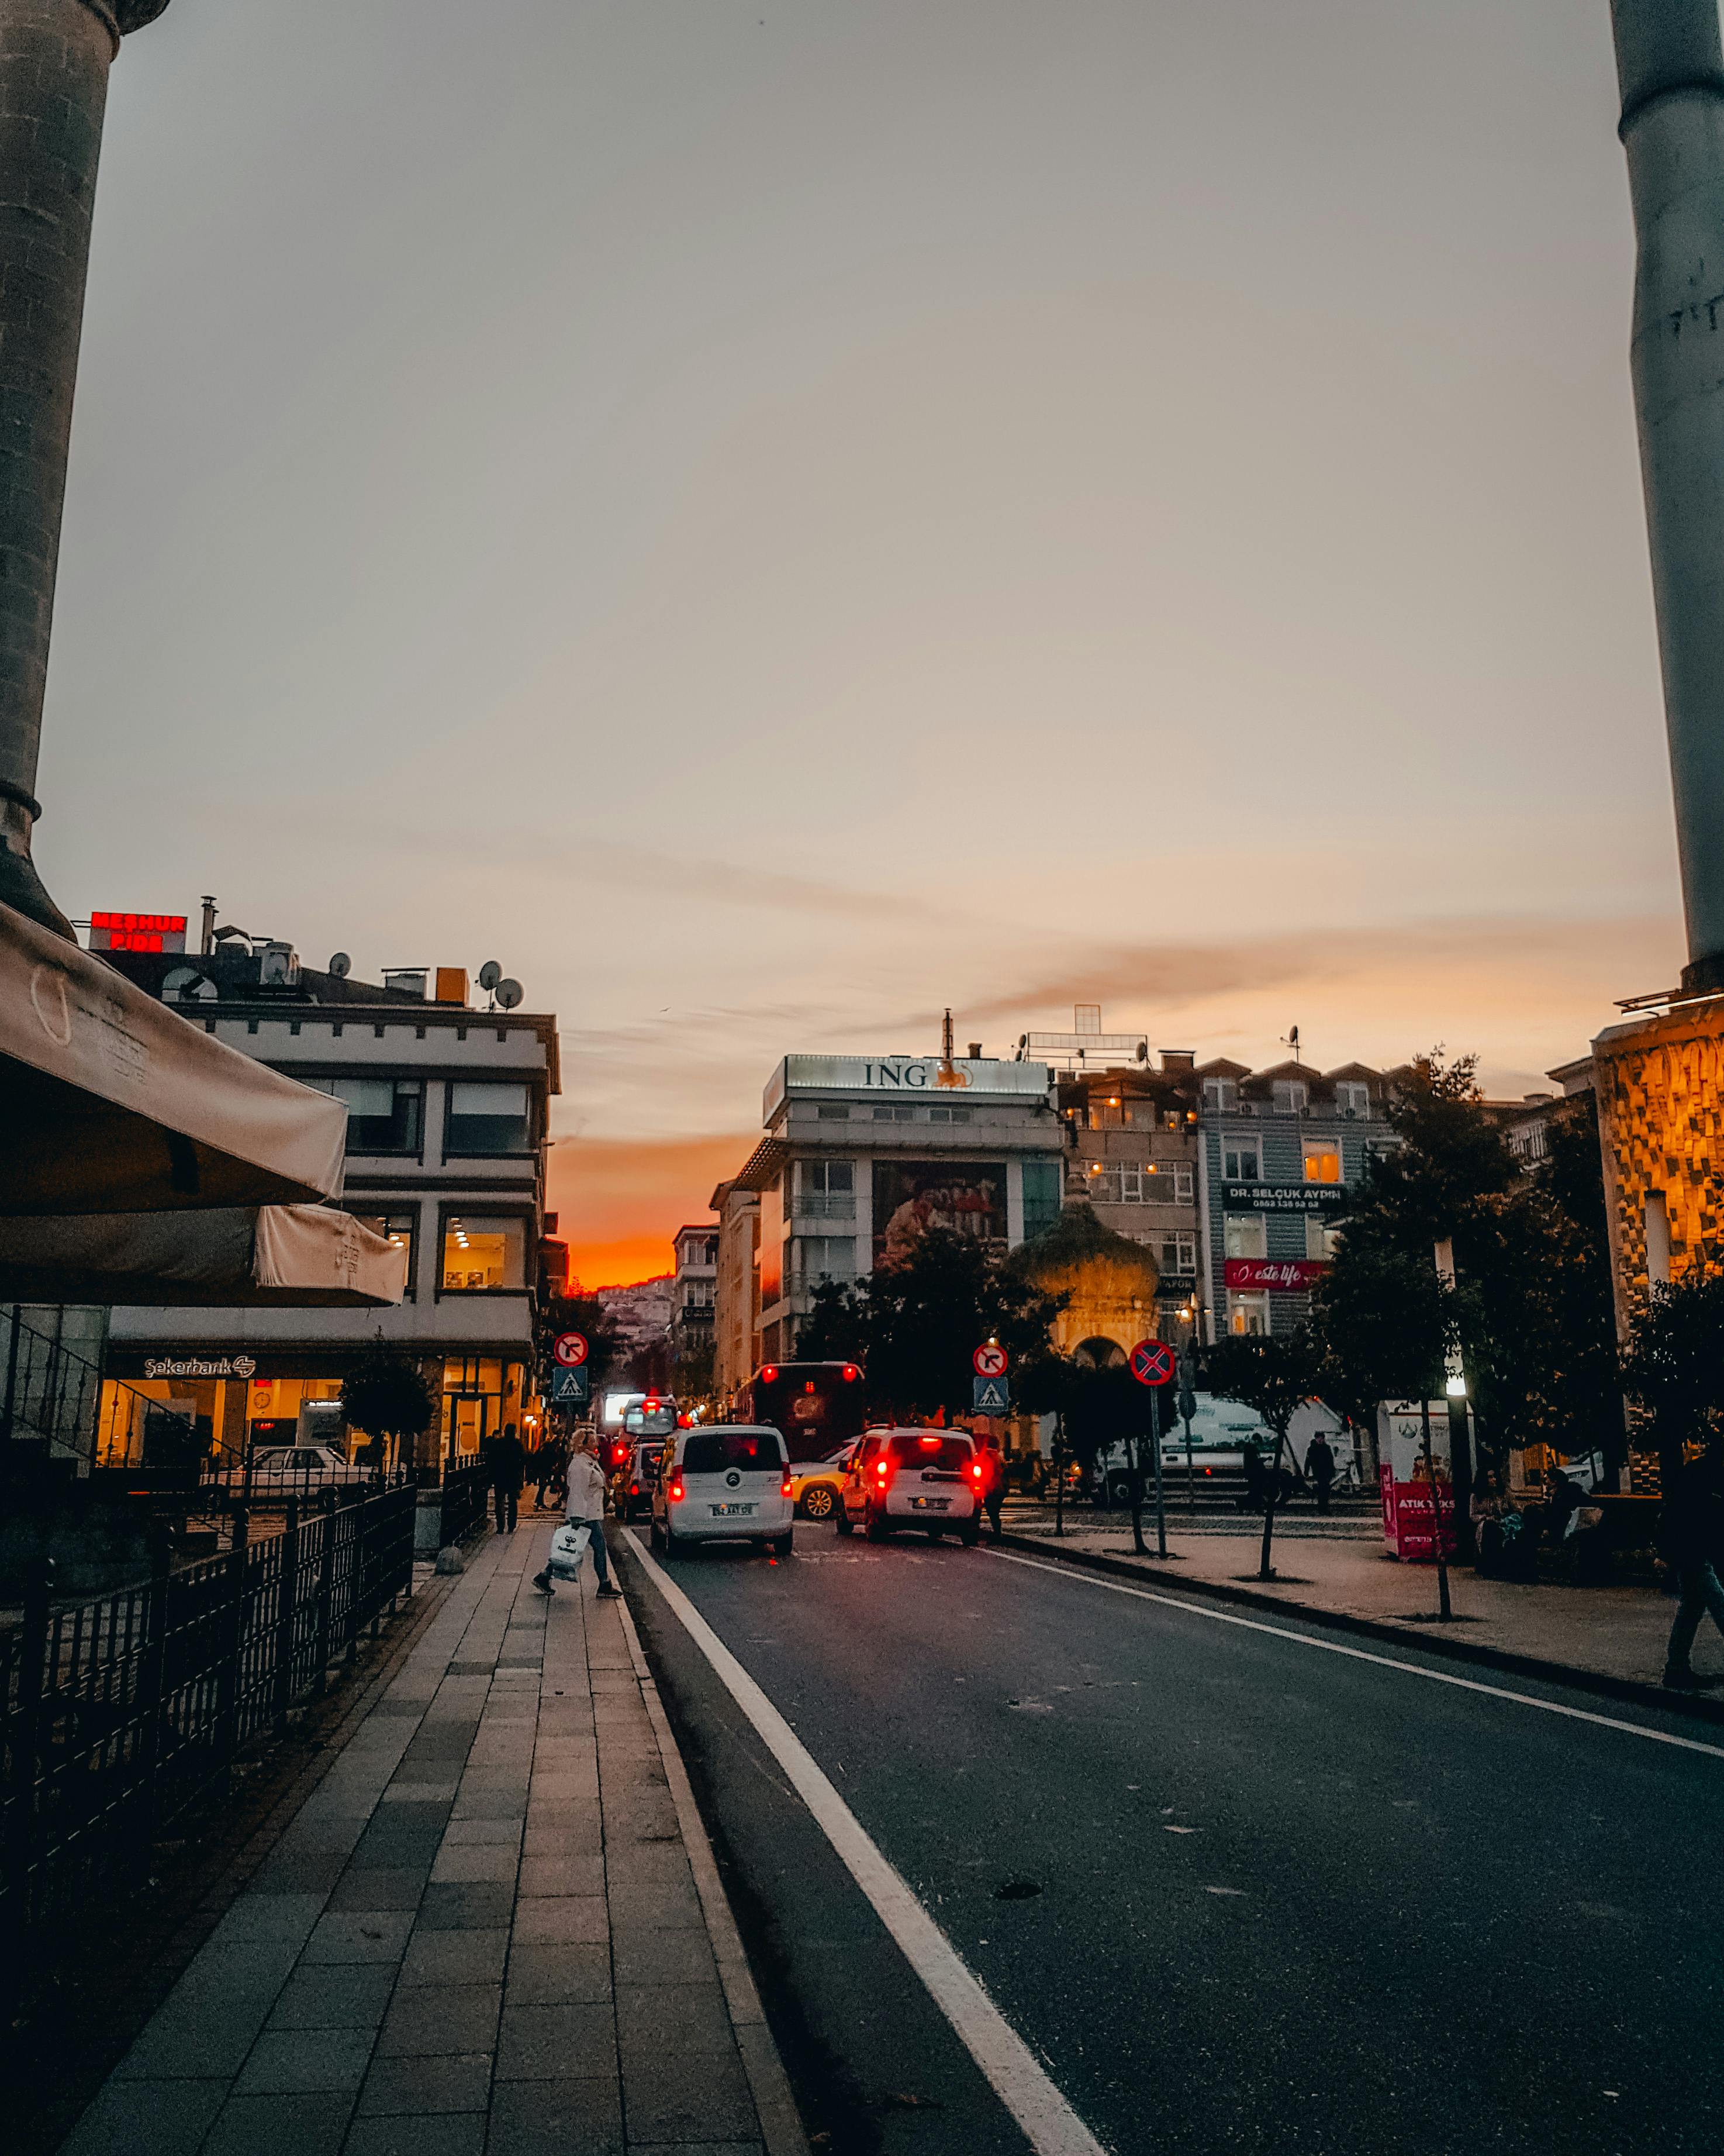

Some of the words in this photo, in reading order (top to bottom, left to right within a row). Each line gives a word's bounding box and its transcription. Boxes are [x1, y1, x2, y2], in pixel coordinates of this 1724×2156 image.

[91, 912, 185, 933] MEŞHUR
[864, 1064, 928, 1086] ING
[1229, 1188, 1251, 1198] DR.
[1252, 1188, 1301, 1200] SELÇUK
[1303, 1189, 1340, 1199] AYDIN
[1255, 1264, 1280, 1281] este
[1280, 1264, 1301, 1286] life
[144, 1357, 232, 1378] Şekerbank
